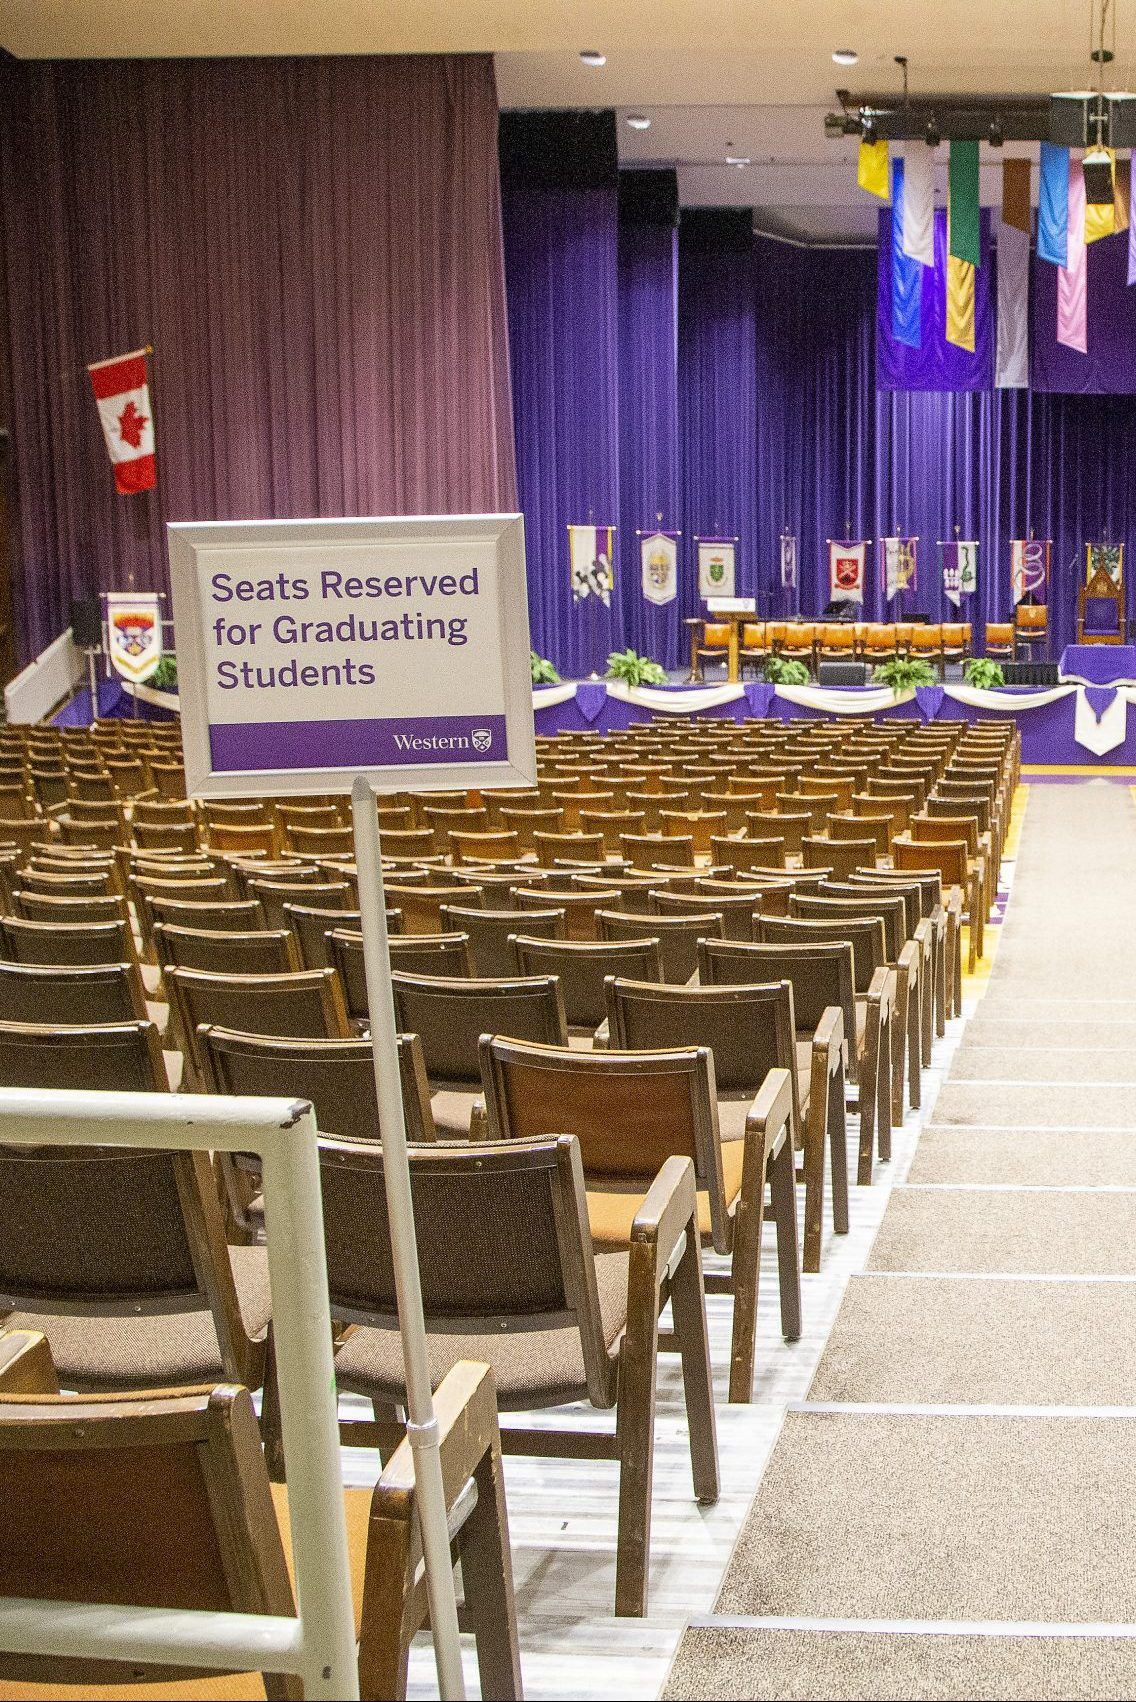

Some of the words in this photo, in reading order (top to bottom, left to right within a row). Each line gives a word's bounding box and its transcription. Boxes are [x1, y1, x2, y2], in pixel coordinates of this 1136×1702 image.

[211, 573, 310, 602] Seats
[320, 567, 480, 600] Reserved
[212, 617, 262, 646] for
[272, 612, 468, 647] Graduating
[216, 658, 376, 690] Students
[392, 734, 470, 751] Western
